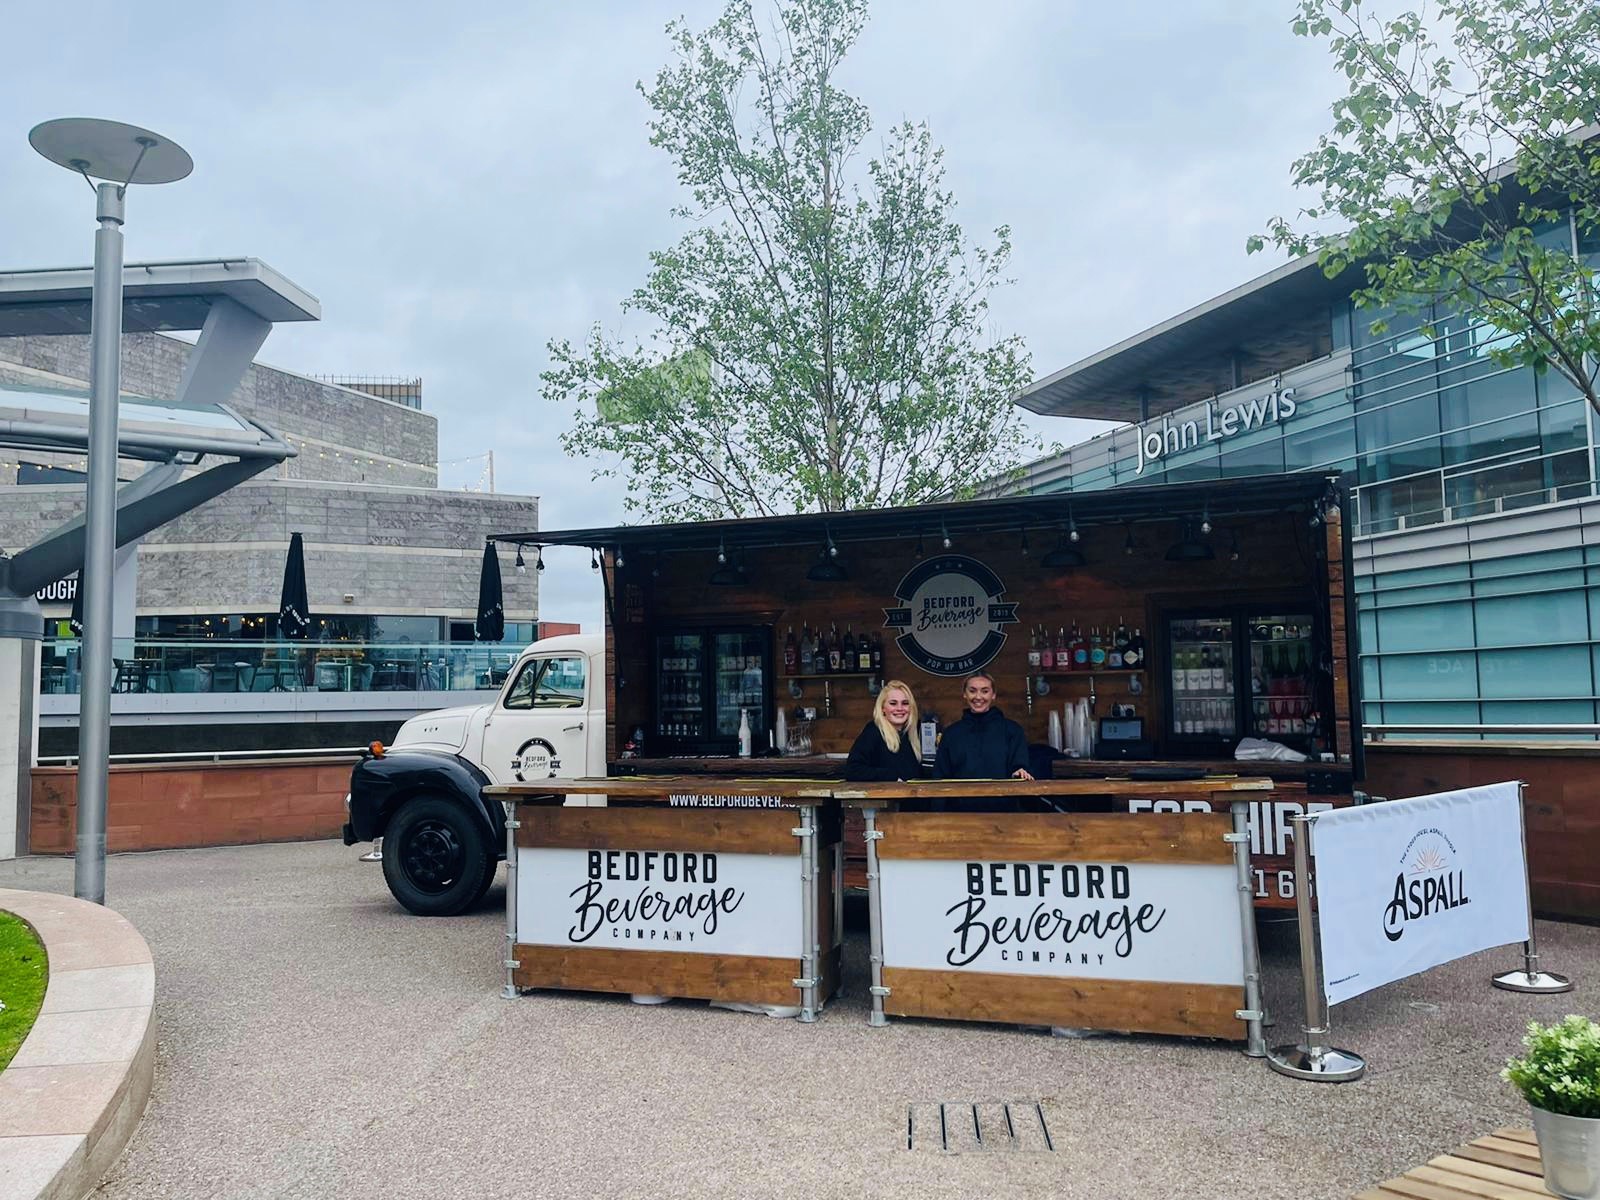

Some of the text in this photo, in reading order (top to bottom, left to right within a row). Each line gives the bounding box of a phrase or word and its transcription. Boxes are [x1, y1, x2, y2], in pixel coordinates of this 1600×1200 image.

[1135, 380, 1297, 475] John Lewis
[923, 596, 975, 609] BEDFORD
[917, 605, 985, 632] Beverage
[926, 658, 941, 669] POP
[958, 659, 974, 670] BAR
[669, 794, 799, 808] WWW.BEDFORDBEVER
[587, 850, 718, 884] BEDFORD
[966, 863, 1130, 900] BEDFORD
[568, 879, 745, 943] Beverage
[1383, 868, 1469, 942] ASPALL
[612, 928, 695, 942] COMPANY
[945, 895, 1167, 967] Beverage
[1001, 949, 1104, 966] COMPANY
